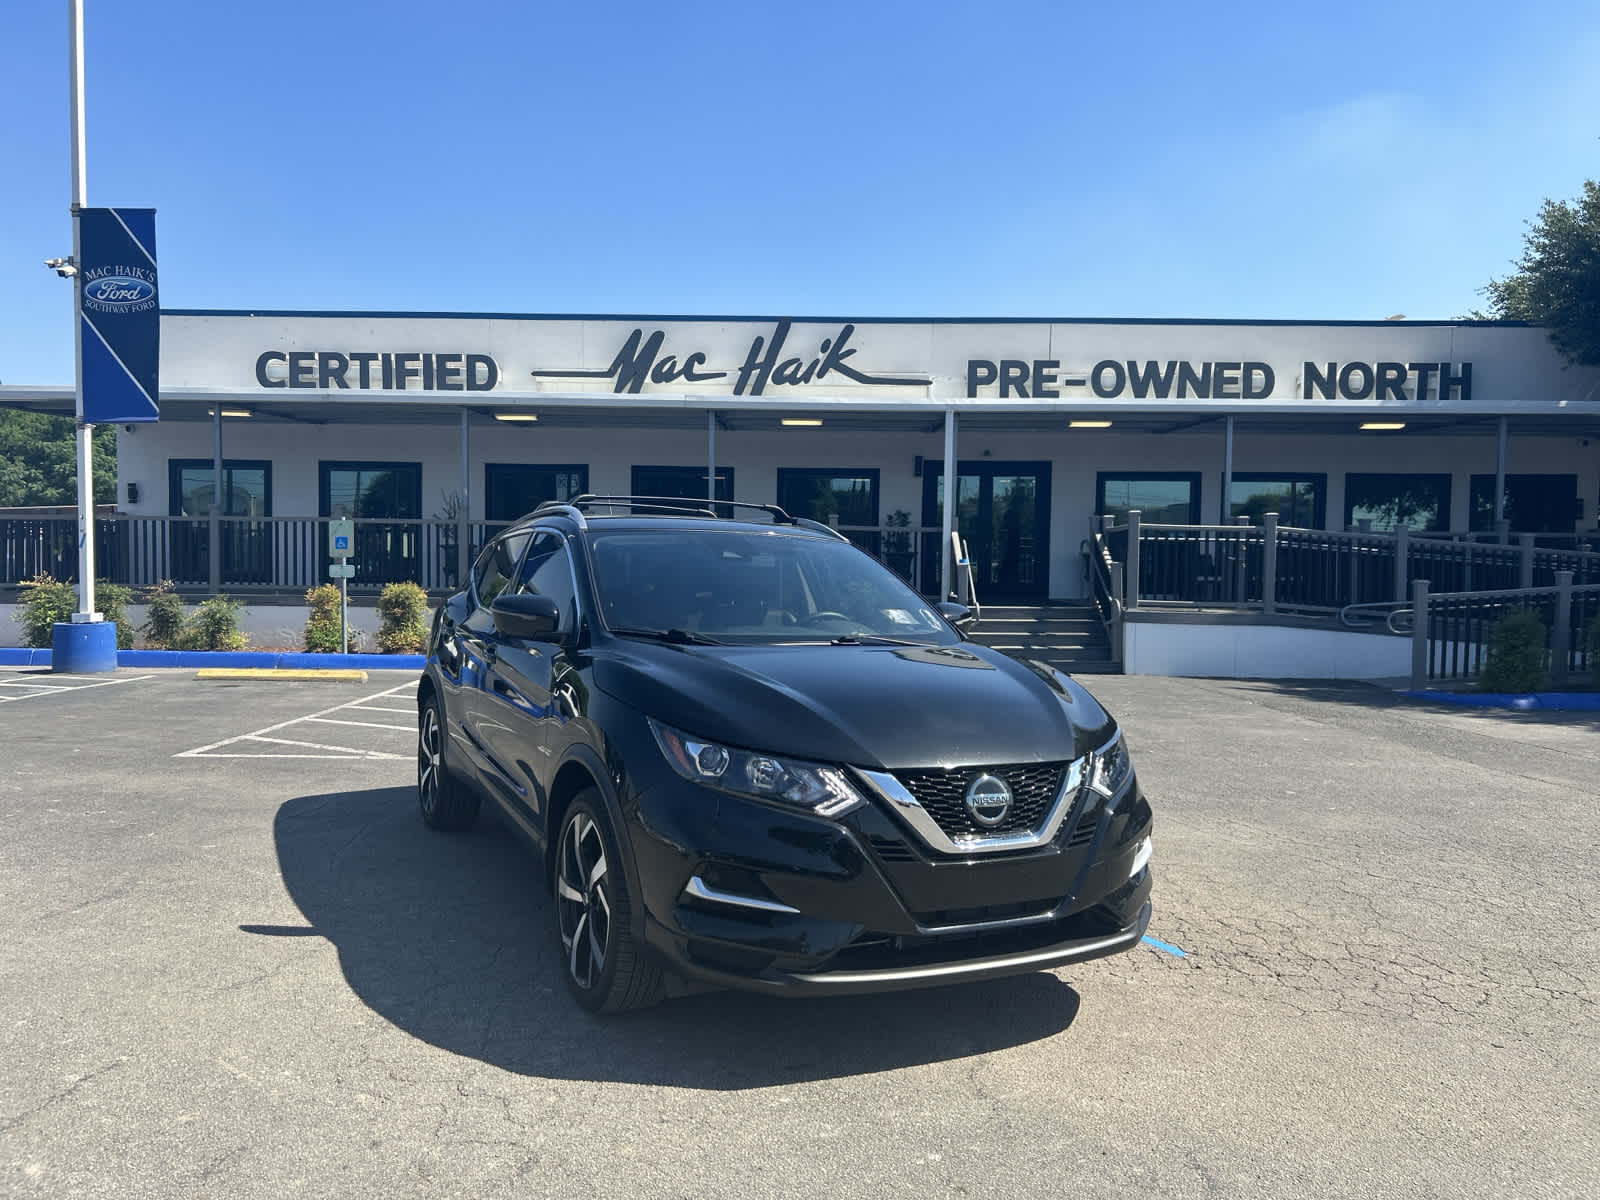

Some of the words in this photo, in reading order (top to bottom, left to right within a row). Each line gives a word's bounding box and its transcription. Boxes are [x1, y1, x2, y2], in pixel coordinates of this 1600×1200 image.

[85, 266, 112, 281] MAC
[115, 265, 155, 282] HAIK'S
[97, 281, 141, 299] Ford
[85, 300, 131, 313] SOUTHWAY
[131, 300, 156, 313] FORD
[531, 329, 727, 394] Mac
[733, 318, 933, 396] Haik
[255, 351, 498, 391] CERTIFIED
[967, 359, 1275, 399] PRE-OWNED
[1303, 361, 1473, 400] NORTH
[972, 796, 1007, 805] NISSAN
